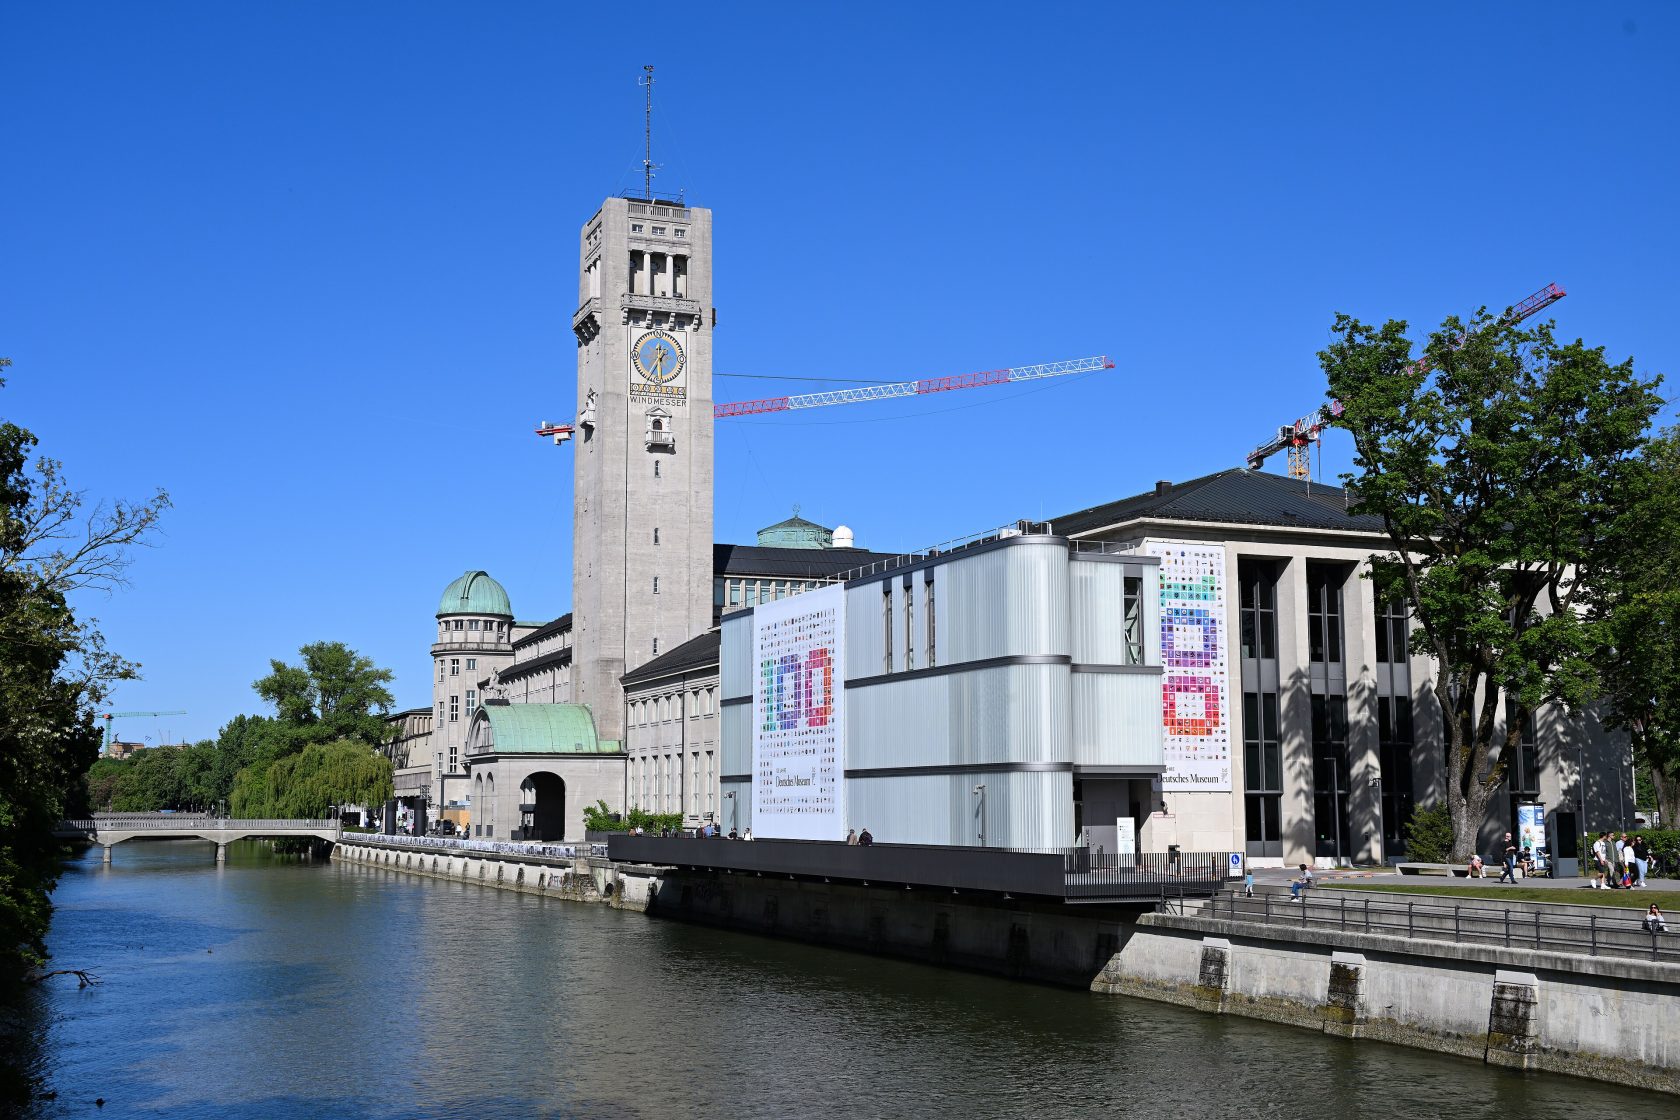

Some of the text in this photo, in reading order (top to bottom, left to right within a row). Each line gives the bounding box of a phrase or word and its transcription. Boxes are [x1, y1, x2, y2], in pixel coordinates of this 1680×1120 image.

[630, 396, 687, 406] WINDMESSER
[1157, 773, 1189, 783] Deutsches
[1190, 773, 1219, 783] Museum
